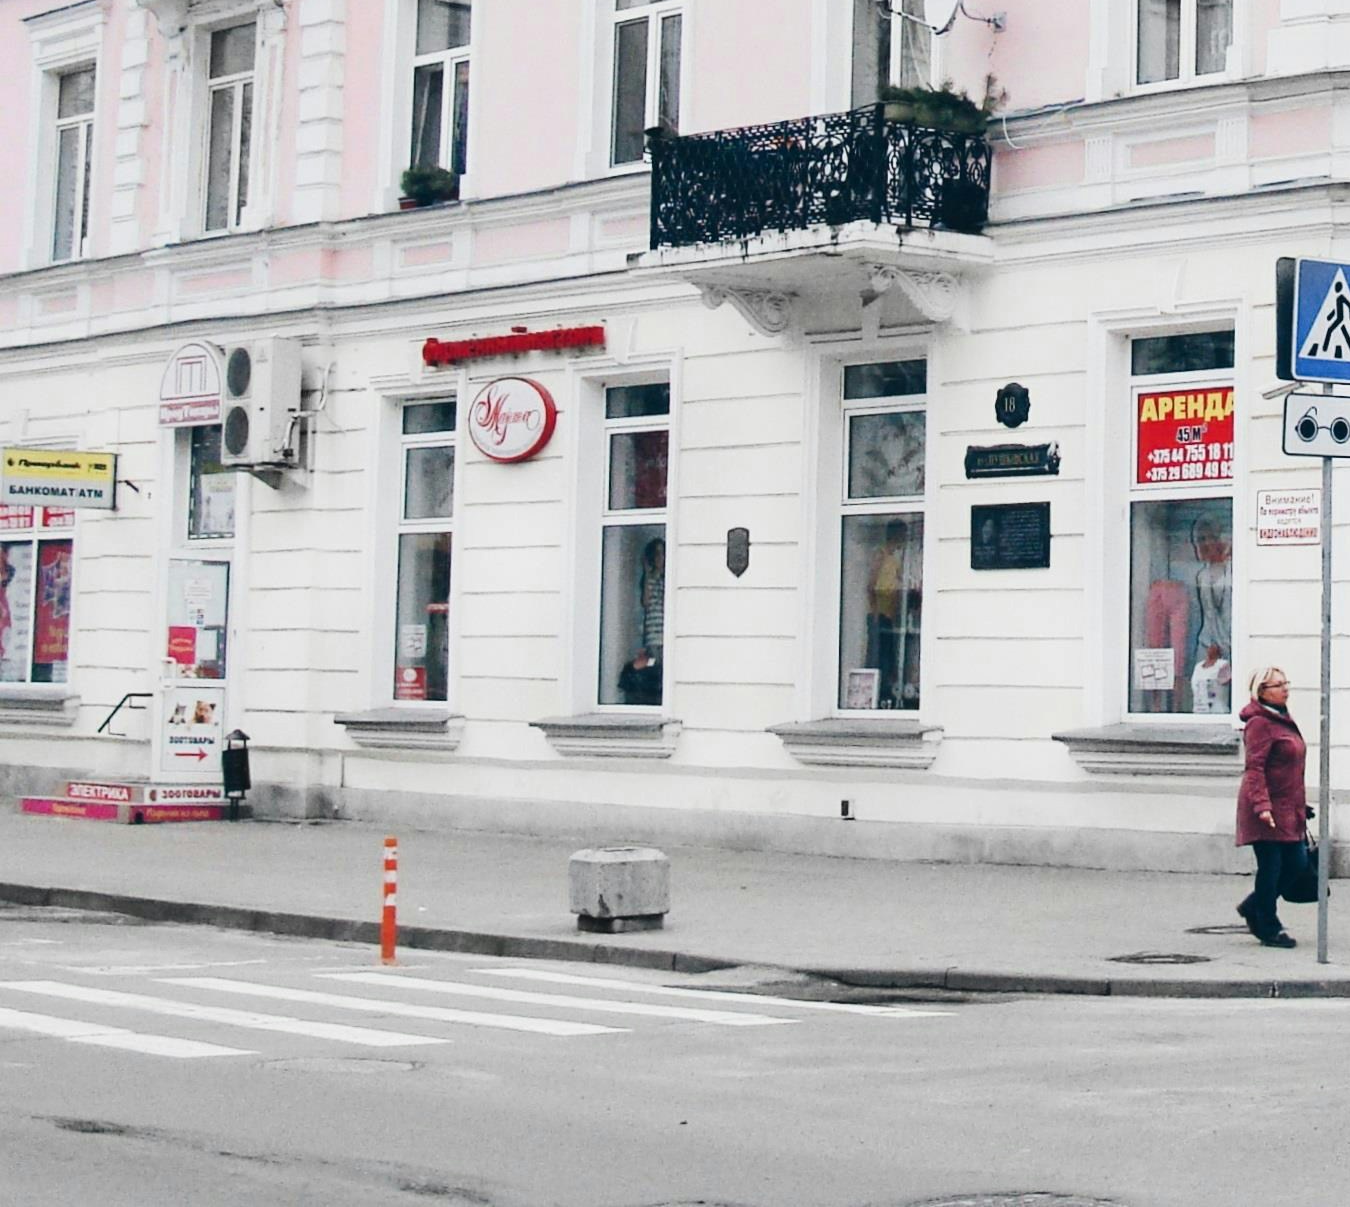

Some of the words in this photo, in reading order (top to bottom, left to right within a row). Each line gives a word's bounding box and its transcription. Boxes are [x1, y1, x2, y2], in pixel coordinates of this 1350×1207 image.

[1004, 397, 1016, 413] 18
[1140, 391, 1234, 422] АРЕНДА
[1176, 426, 1191, 443] 45
[1147, 449, 1170, 464] +375
[1171, 447, 1184, 462] 44
[1185, 444, 1206, 461] 755
[9, 485, 75, 497] БАНКОМАТ
[78, 488, 103, 498] АТМ
[1265, 493, 1314, 505] Внимание!
[68, 783, 130, 801] ЭЛЕКТРИКА
[161, 788, 222, 799] ЗООТОВАРЫ
